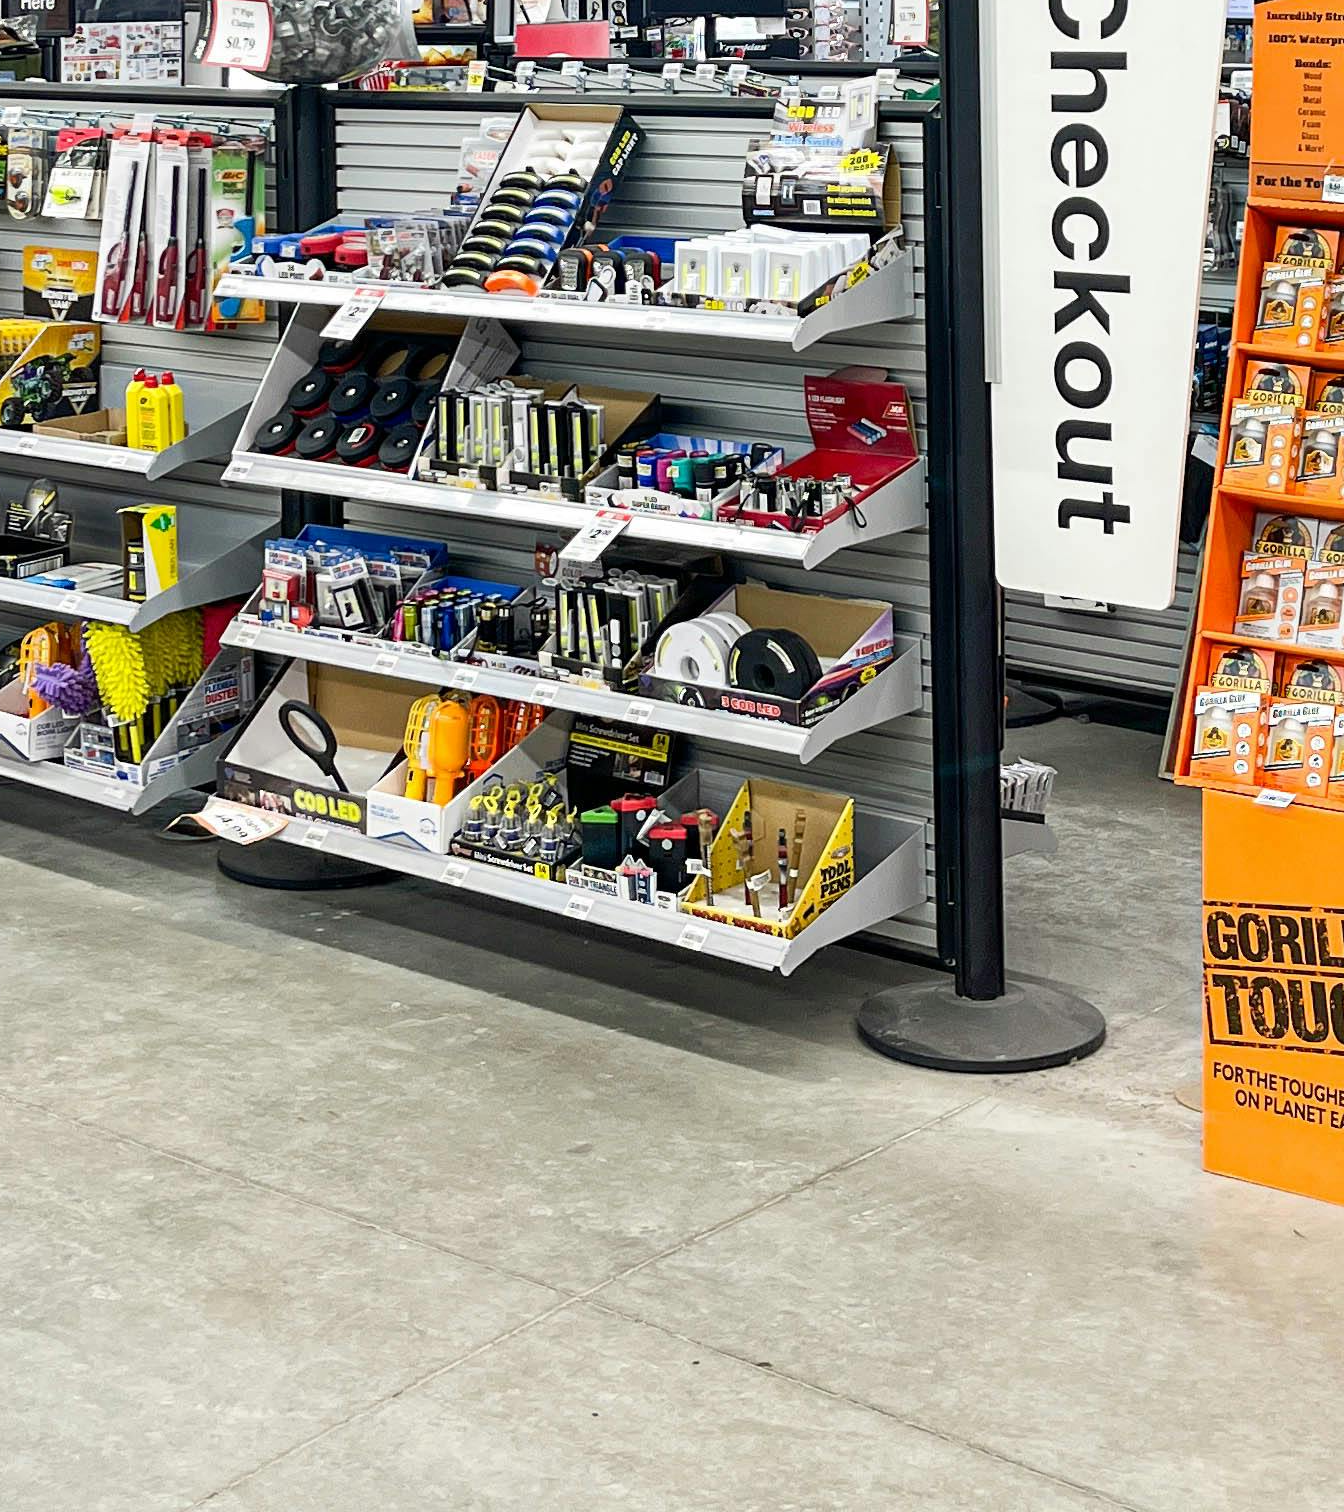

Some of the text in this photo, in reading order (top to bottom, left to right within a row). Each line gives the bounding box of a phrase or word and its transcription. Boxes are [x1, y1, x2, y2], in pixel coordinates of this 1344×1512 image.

[1266, 10, 1323, 24] Incredibly
[225, 34, 256, 51] $0.79
[1268, 34, 1297, 45] 100%
[1294, 58, 1332, 69] Bonds:
[788, 105, 841, 118] COB LED
[788, 122, 836, 133] Wireless
[806, 135, 844, 148] Switch
[1256, 175, 1277, 187] For
[1280, 175, 1302, 188] the
[1282, 257, 1326, 270] GORILLA
[1252, 393, 1296, 407] GORILLA
[730, 698, 781, 717] COB LED
[627, 731, 640, 744] Set
[293, 788, 327, 818] COB
[328, 799, 362, 824] LED
[819, 862, 851, 884] TOOL
[819, 875, 852, 899] PENS
[1213, 1061, 1244, 1085] FOR
[1246, 1068, 1278, 1092] THE
[1235, 1089, 1260, 1110] ON
[1264, 1097, 1327, 1126] PLANET
